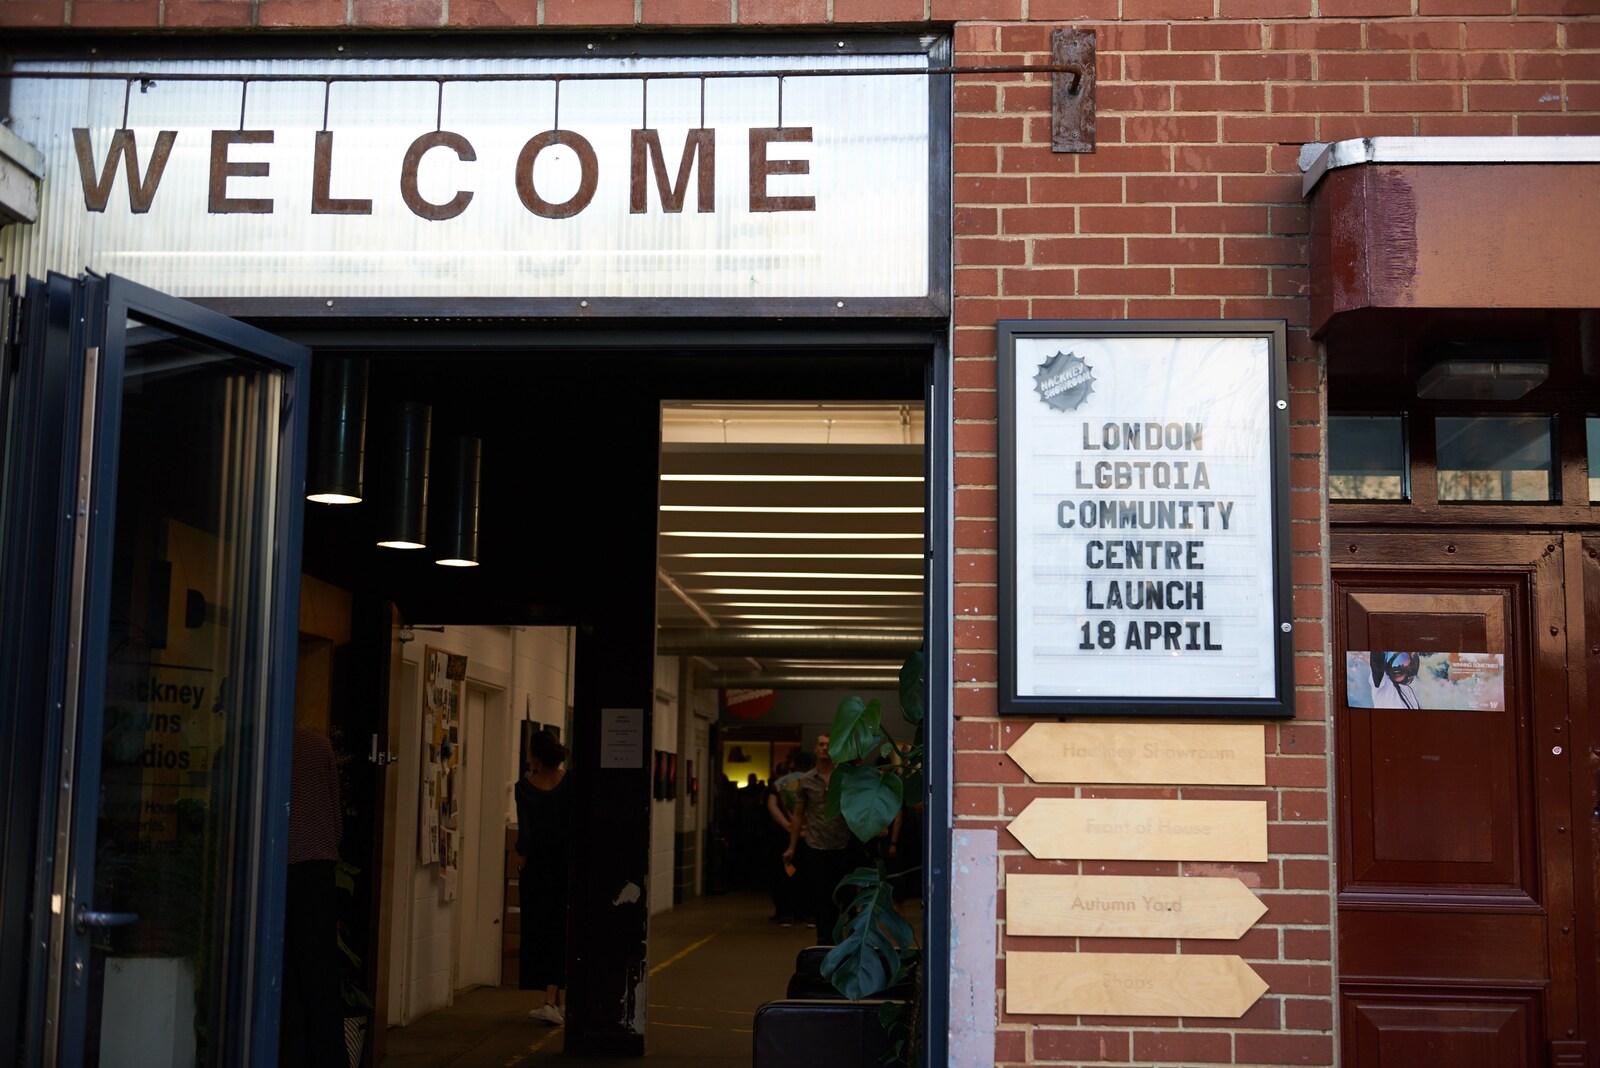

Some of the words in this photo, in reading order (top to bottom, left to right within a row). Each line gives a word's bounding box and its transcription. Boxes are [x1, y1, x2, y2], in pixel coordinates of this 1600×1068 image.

[73, 127, 816, 220] WELCOME
[1040, 362, 1084, 391] HACKNEY
[1043, 371, 1091, 399] SHOWROOM
[1082, 422, 1204, 451] LONDON
[1075, 461, 1211, 491] LGBTQIA
[1057, 500, 1234, 531] COMMUNITY
[1085, 540, 1205, 570] CENTRE
[1086, 580, 1204, 610] LAUNCH
[1079, 620, 1116, 650] 18
[1125, 620, 1222, 651] APRIL
[1062, 743, 1134, 762] Hackney
[1143, 743, 1236, 760] Showroom
[1086, 819, 1129, 835] Front
[1136, 818, 1154, 835] of
[1158, 820, 1212, 837] House
[1071, 895, 1136, 911] Autumn
[1142, 895, 1183, 912] Yard
[1102, 973, 1154, 991] Shops
